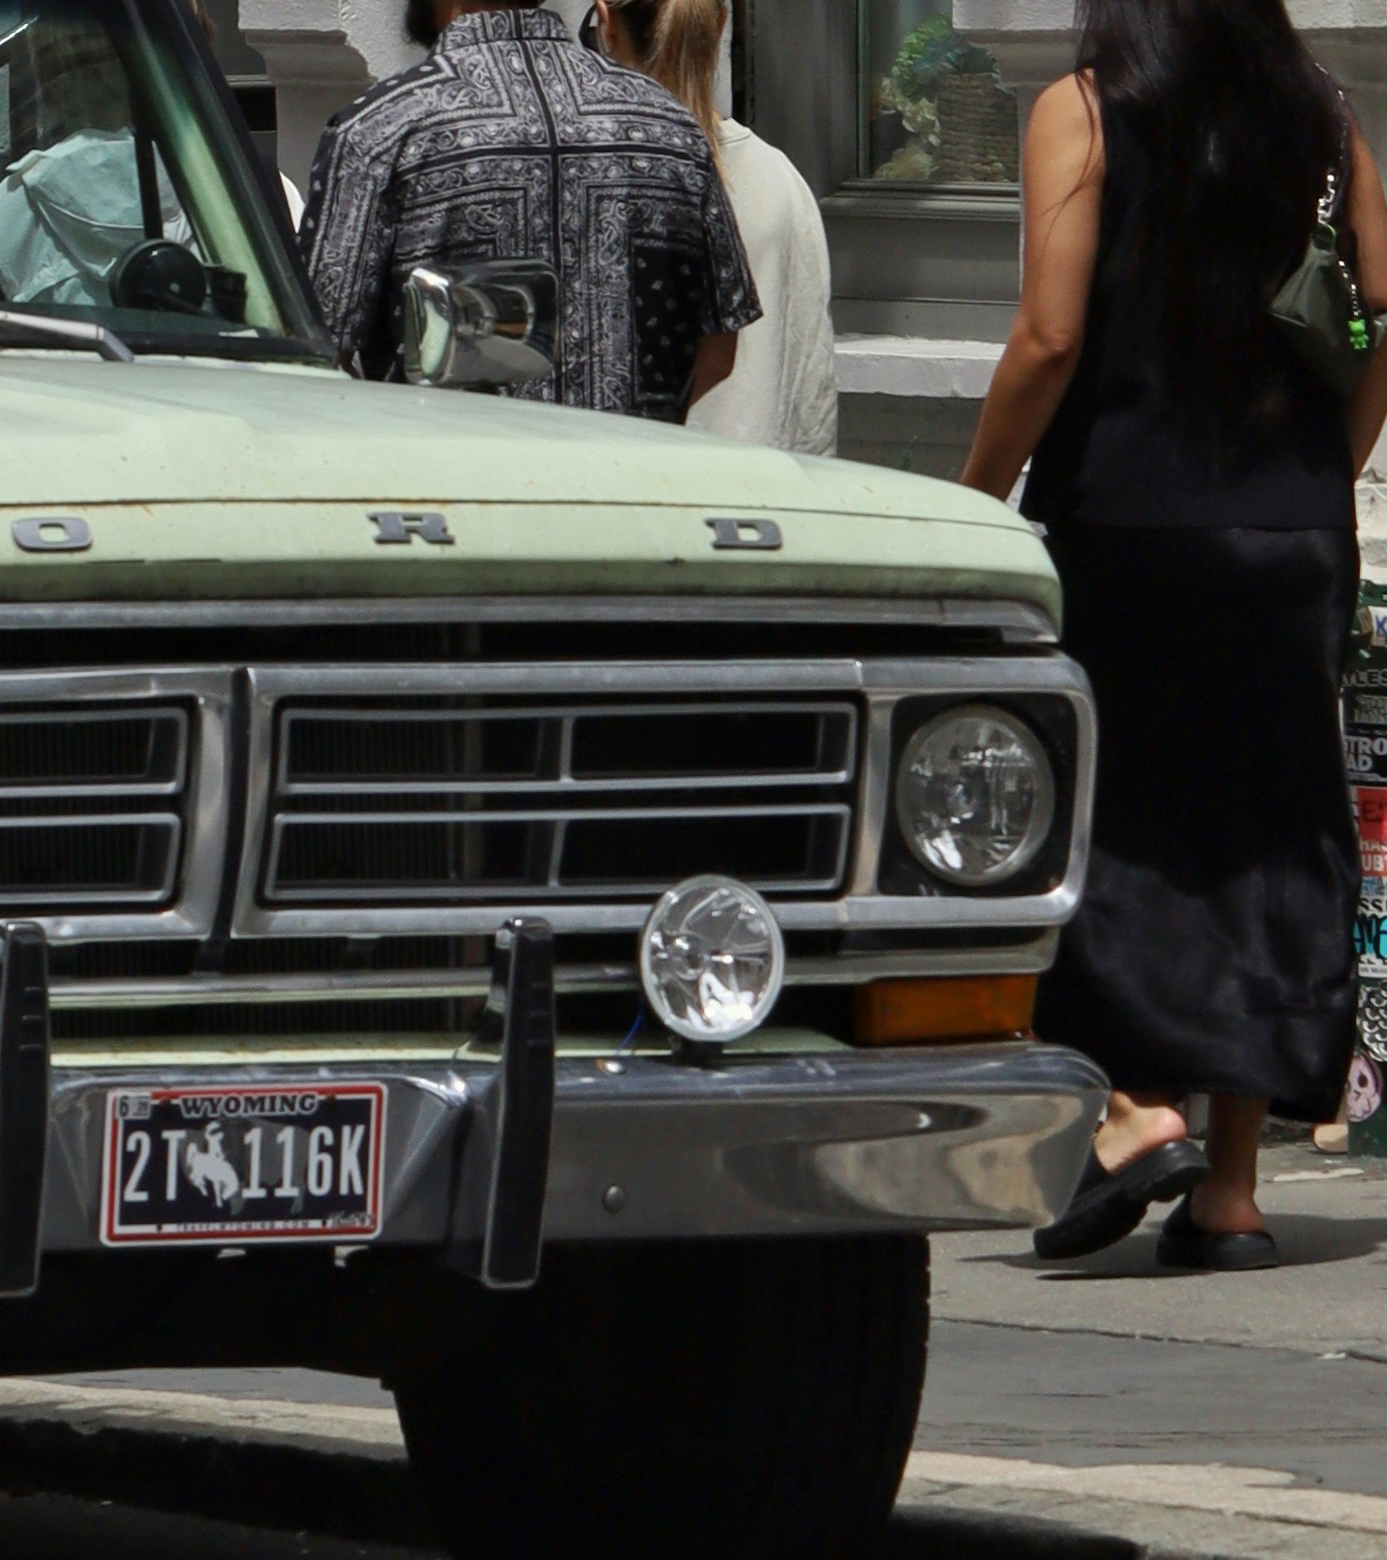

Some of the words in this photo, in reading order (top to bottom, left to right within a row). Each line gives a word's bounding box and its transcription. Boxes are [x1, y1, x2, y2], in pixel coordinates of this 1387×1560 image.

[181, 1094, 319, 1118] WYOMING
[124, 1129, 188, 1203] 2T
[241, 1124, 366, 1199] 116K
